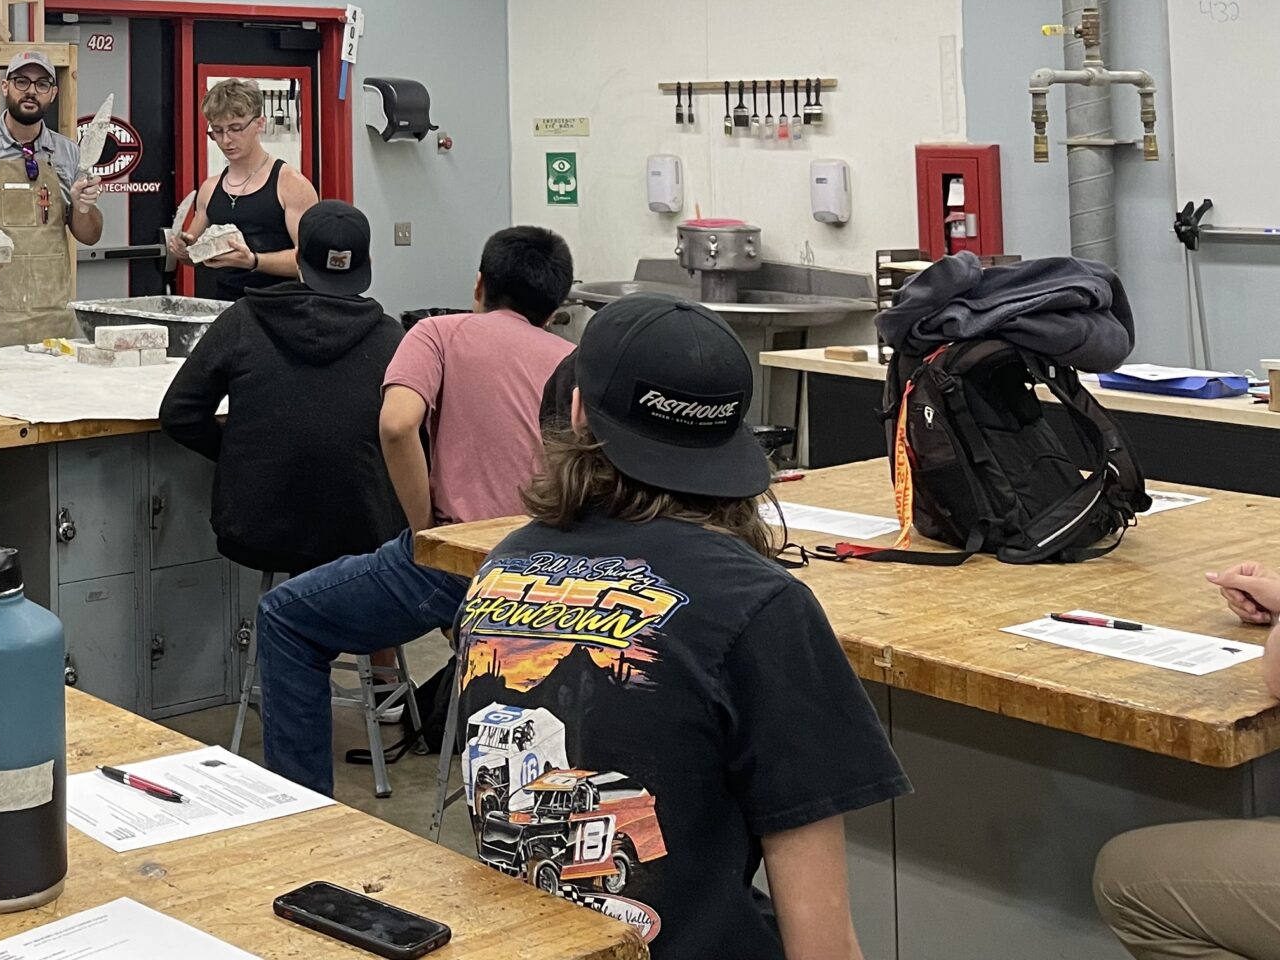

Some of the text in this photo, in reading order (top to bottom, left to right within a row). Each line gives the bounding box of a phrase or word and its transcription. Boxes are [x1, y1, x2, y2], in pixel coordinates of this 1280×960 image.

[1199, 0, 1240, 23] 432
[88, 35, 113, 50] 402
[347, 9, 357, 56] 402
[104, 183, 162, 192] TECHNOLOGY
[523, 555, 656, 590] Bill & Shirley
[460, 596, 663, 639] SHOWDOWN
[574, 820, 605, 861] 18
